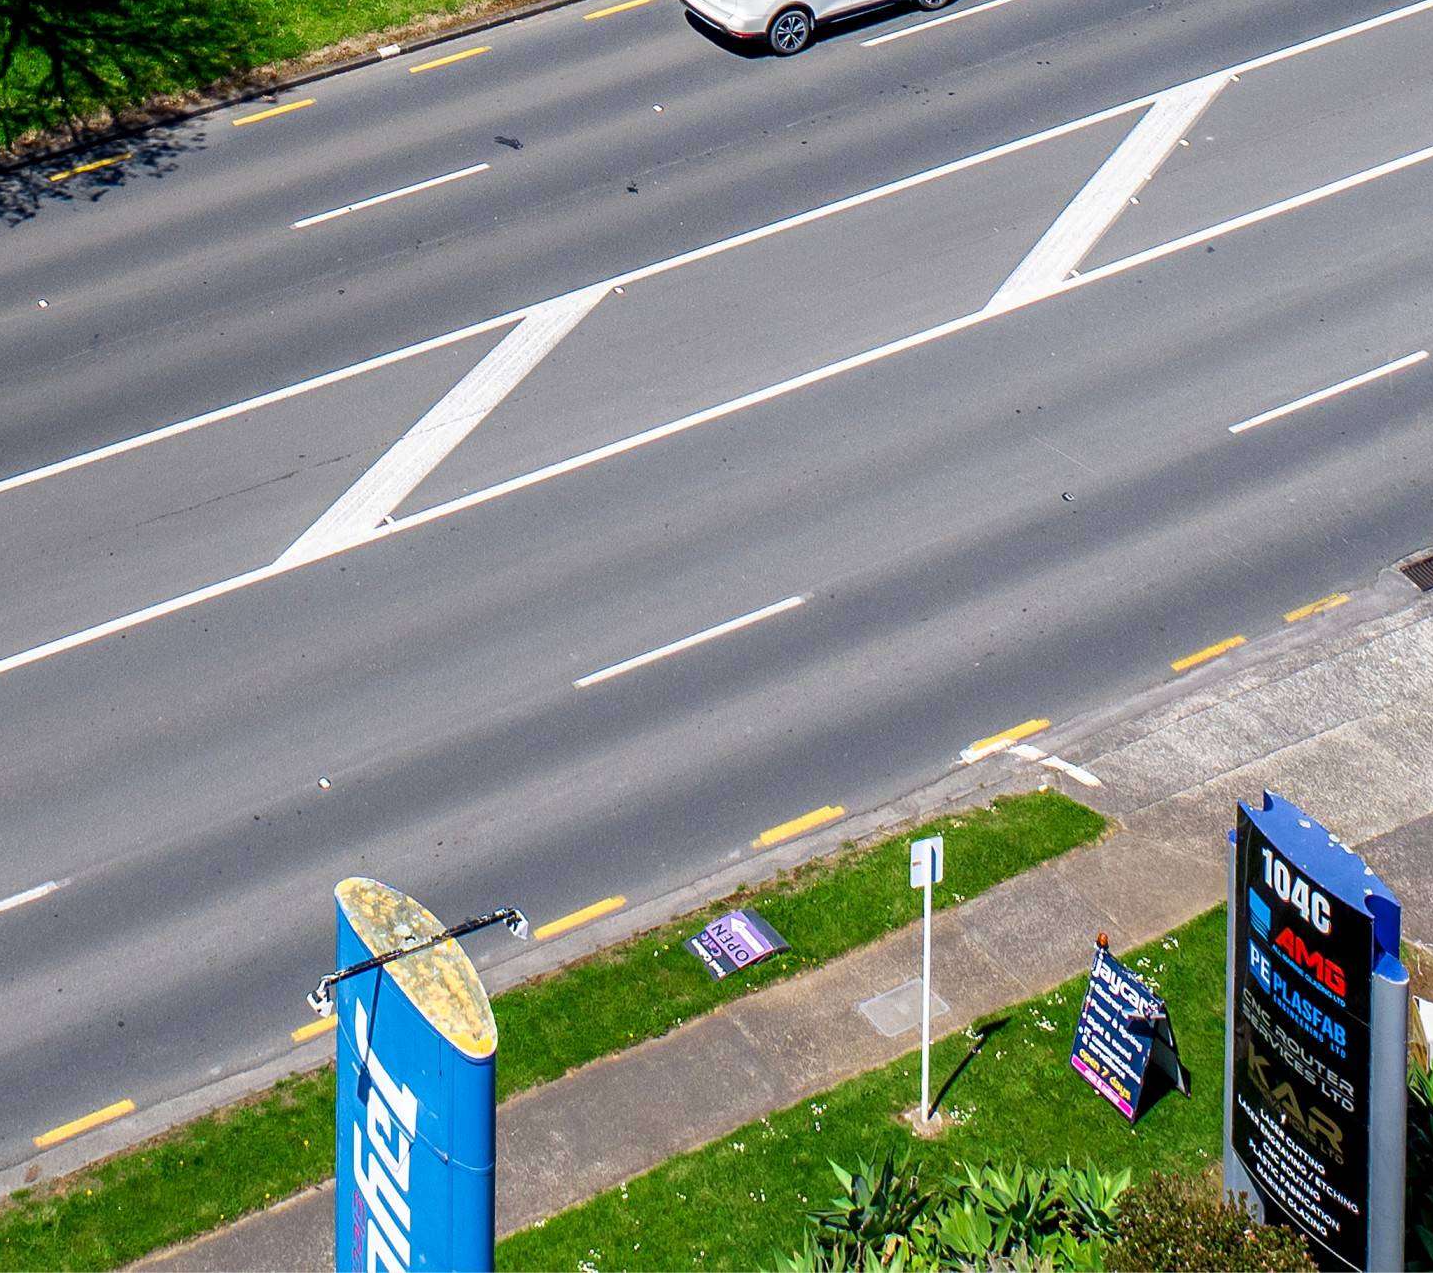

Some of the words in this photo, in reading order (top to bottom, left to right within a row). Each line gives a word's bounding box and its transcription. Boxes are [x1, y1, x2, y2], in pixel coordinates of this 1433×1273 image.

[1262, 847, 1331, 934] 104C
[712, 924, 749, 961] OPEN
[1250, 940, 1270, 984] PE
[1275, 926, 1346, 997] AMG
[1092, 953, 1149, 1018] jaycar
[1273, 972, 1346, 1046] PLASFAB
[1333, 995, 1346, 1008] LTD
[1243, 988, 1271, 1026] CNC
[1276, 1025, 1354, 1097] ROUTER
[1243, 1003, 1317, 1086] SERVICES
[1321, 1082, 1354, 1112] LTD
[1273, 994, 1324, 1042] ENGINEERING
[1331, 1043, 1346, 1059] LTD
[1079, 1049, 1100, 1072] open
[1101, 1066, 1109, 1077] 7
[1110, 1076, 1131, 1101] days
[1249, 1137, 1279, 1178] PLASTIC
[1279, 1174, 1341, 1232] FABRICATION
[1260, 1124, 1307, 1174] ENGRAVING
[1315, 1176, 1360, 1215] ETCHING
[1263, 1141, 1280, 1164] CNC
[1280, 1160, 1321, 1202] ROUTING
[1286, 1136, 1326, 1175] CUTTING
[1257, 1163, 1286, 1201] MARINE
[1287, 1197, 1328, 1238] GLAZING
